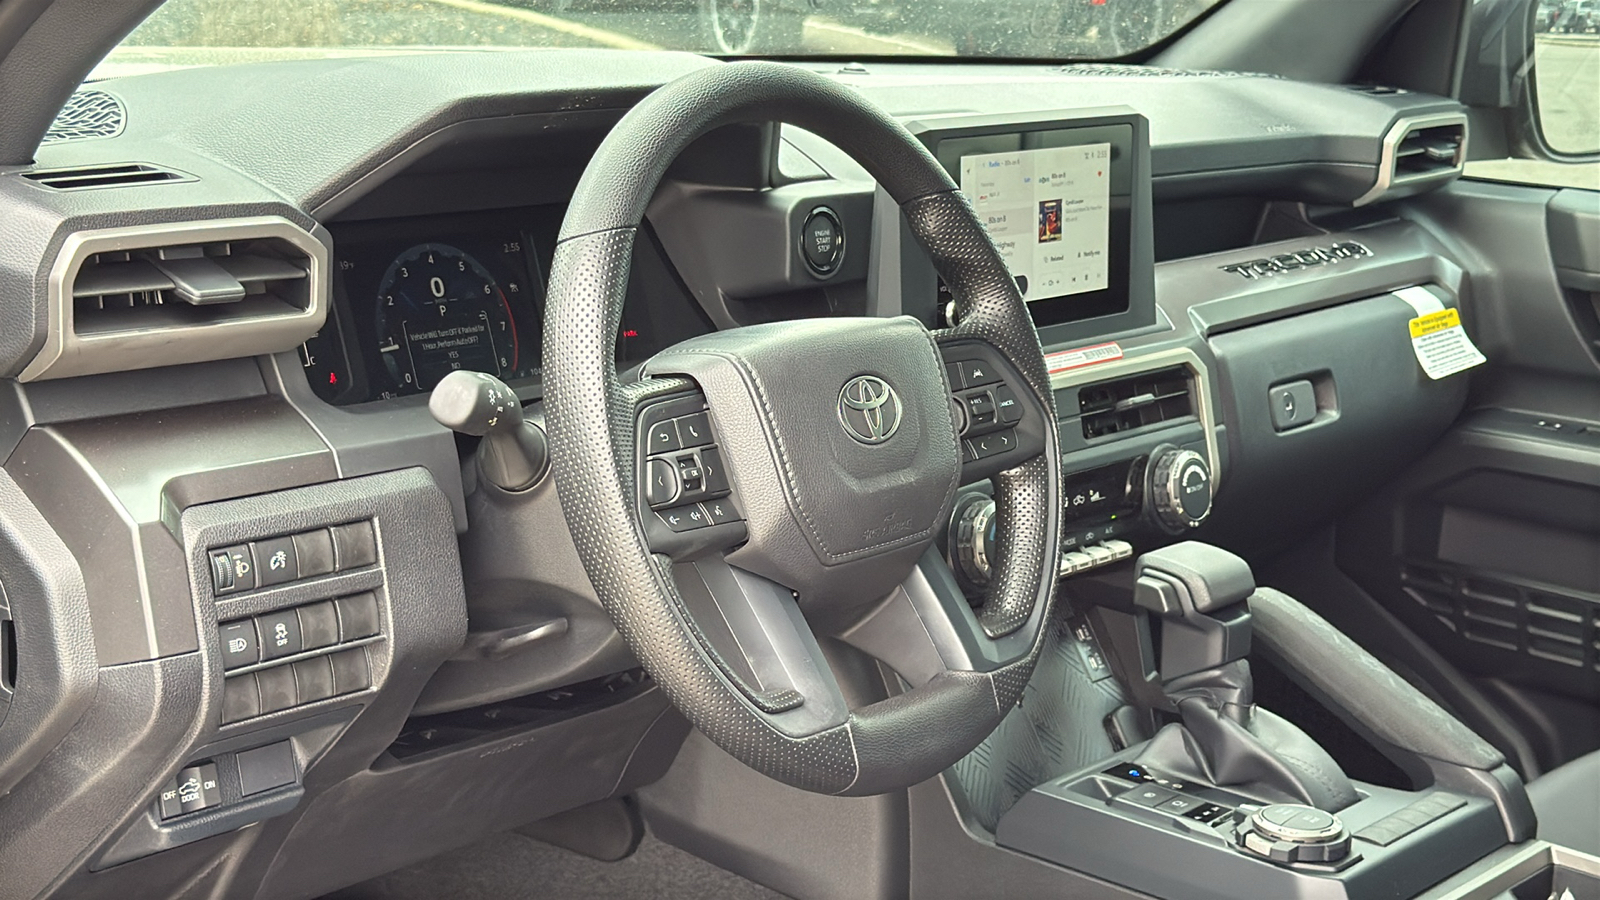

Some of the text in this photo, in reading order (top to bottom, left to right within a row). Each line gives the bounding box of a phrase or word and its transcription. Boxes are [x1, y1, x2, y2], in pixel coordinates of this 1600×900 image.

[428, 254, 434, 264] 4
[458, 261, 465, 271] 5
[401, 267, 409, 278] 3
[430, 277, 445, 298] 0
[484, 284, 491, 295] 6
[387, 295, 394, 306] 2
[439, 305, 447, 316] P
[500, 321, 506, 331] 7
[448, 351, 459, 359] YES
[451, 362, 461, 370] NO
[501, 357, 508, 367] 8
[405, 373, 412, 383] 0
[204, 779, 216, 790] ON
[163, 789, 177, 800] OFF
[182, 791, 199, 802] DOOR
